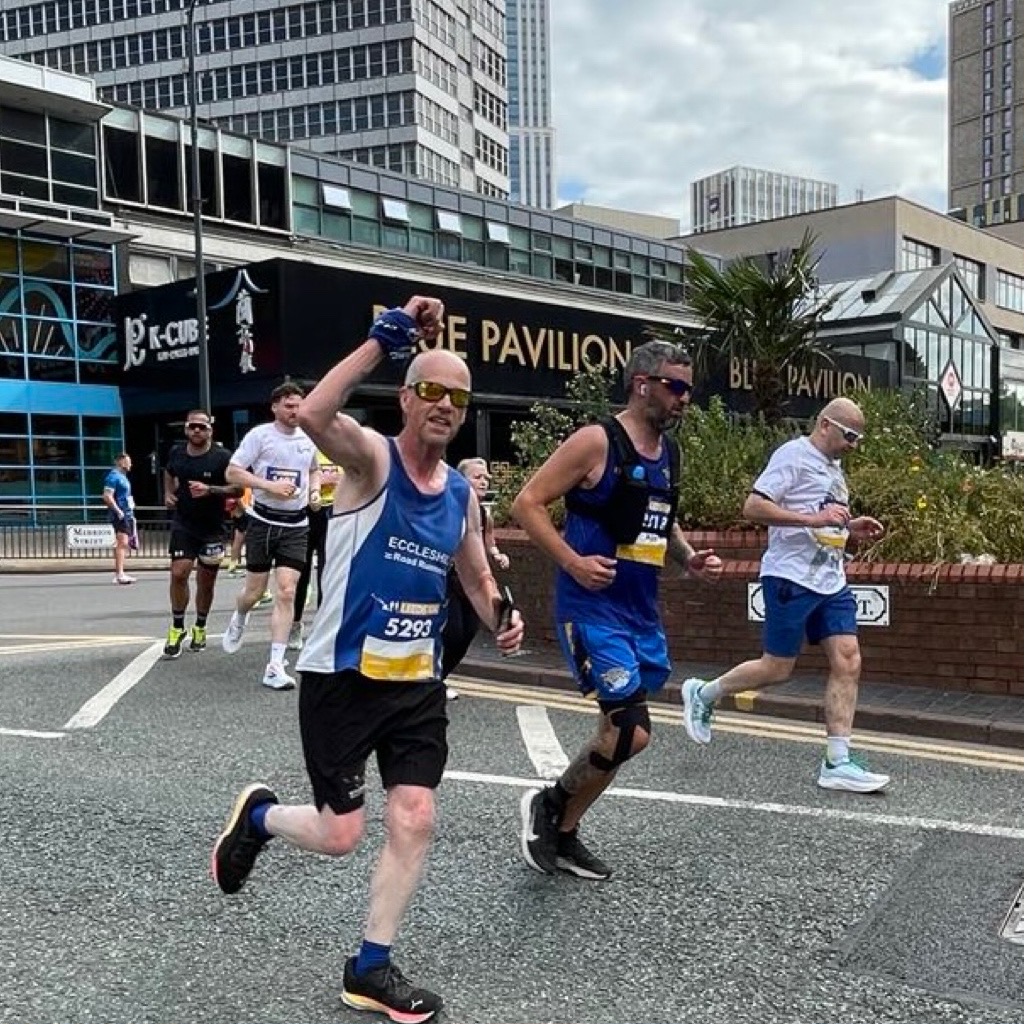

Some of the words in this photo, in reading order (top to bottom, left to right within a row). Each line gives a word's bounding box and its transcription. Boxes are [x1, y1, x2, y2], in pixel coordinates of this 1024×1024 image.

[481, 319, 632, 372] PAVILION
[853, 593, 875, 616] T.
[384, 617, 432, 638] 5293
